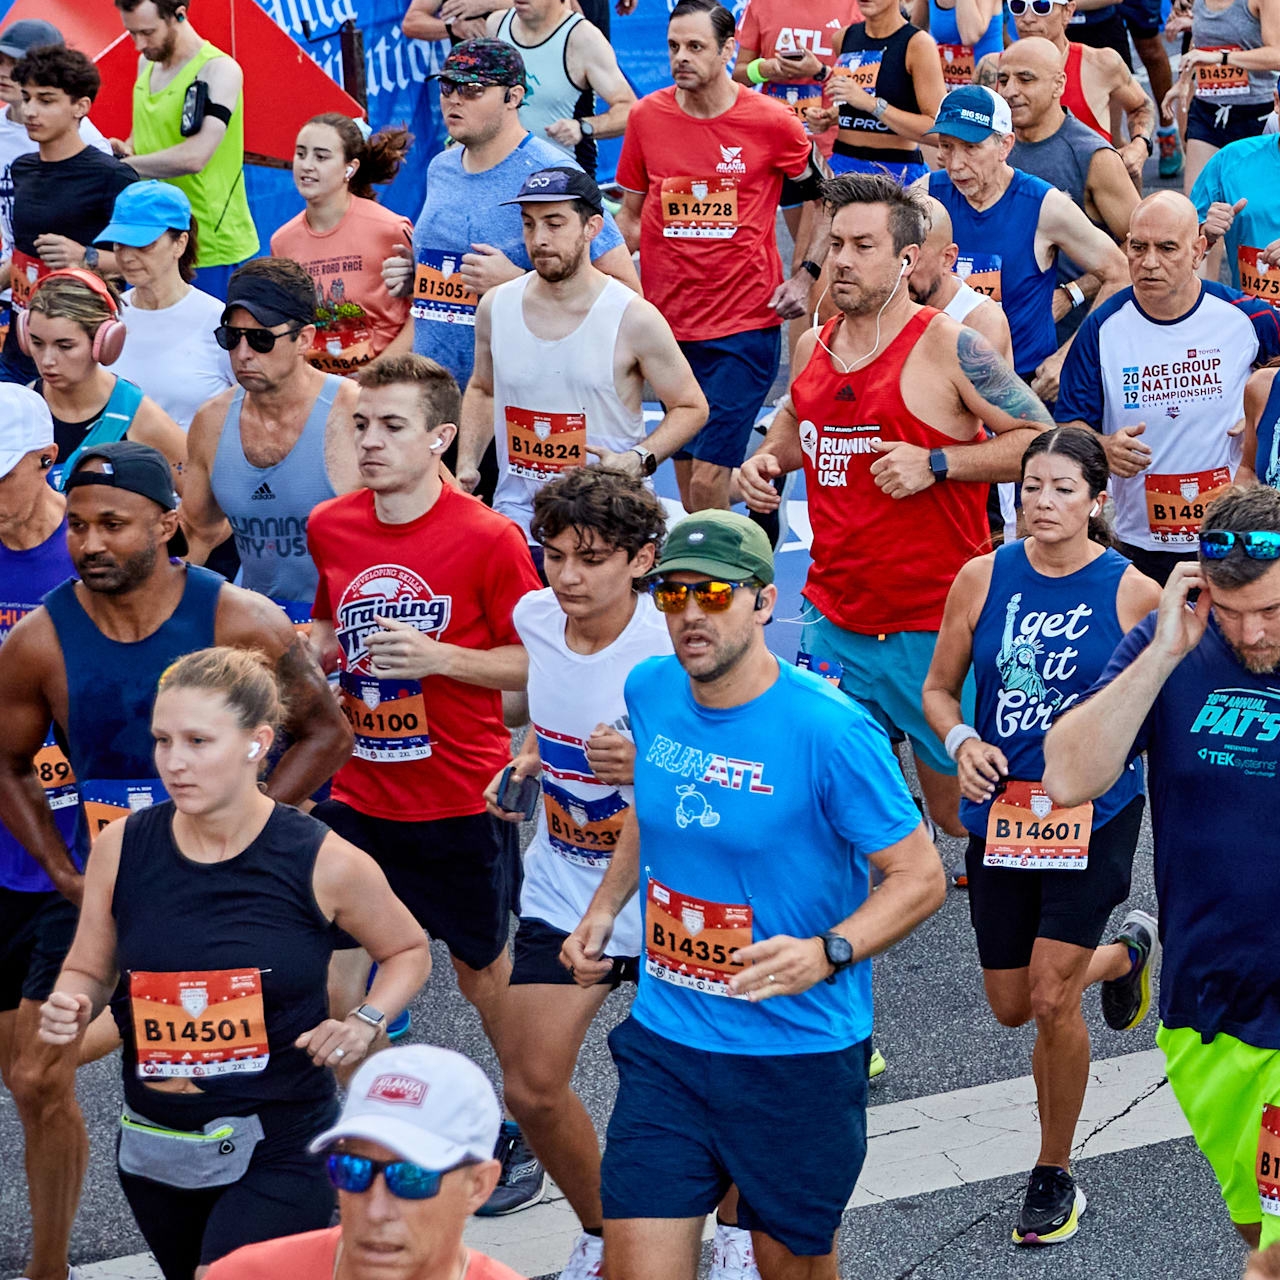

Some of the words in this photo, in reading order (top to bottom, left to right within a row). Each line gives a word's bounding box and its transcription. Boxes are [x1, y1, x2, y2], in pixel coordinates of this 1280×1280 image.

[775, 27, 833, 56] ATL
[943, 64, 972, 75] 4064
[1198, 66, 1245, 79] B14579
[962, 108, 976, 119] BIG
[668, 203, 732, 216] B14728
[321, 262, 341, 274] ROAD
[342, 260, 362, 272] RACE
[1198, 348, 1220, 356] TOYOTA
[1142, 363, 1168, 378] AGE
[1171, 358, 1221, 375] GROUP
[1123, 372, 1138, 385] 20
[1142, 372, 1222, 392] NATIONAL
[1123, 392, 1138, 405] 19
[1142, 385, 1223, 403] CHAMPIONSHIPS
[512, 435, 580, 459] B14824
[819, 454, 852, 471] CITY
[818, 470, 848, 487] USA
[252, 492, 276, 500] adidas
[349, 566, 397, 594] DEVELOPING
[398, 566, 425, 593] SKILLS
[341, 596, 444, 626] Training
[1020, 604, 1093, 650] get
[1043, 648, 1077, 681] it
[1229, 694, 1266, 712] ANNUAL
[340, 711, 419, 733] B14100
[995, 818, 1081, 841] B14601
[653, 923, 745, 966] B14352
[144, 1018, 251, 1043] B14501
